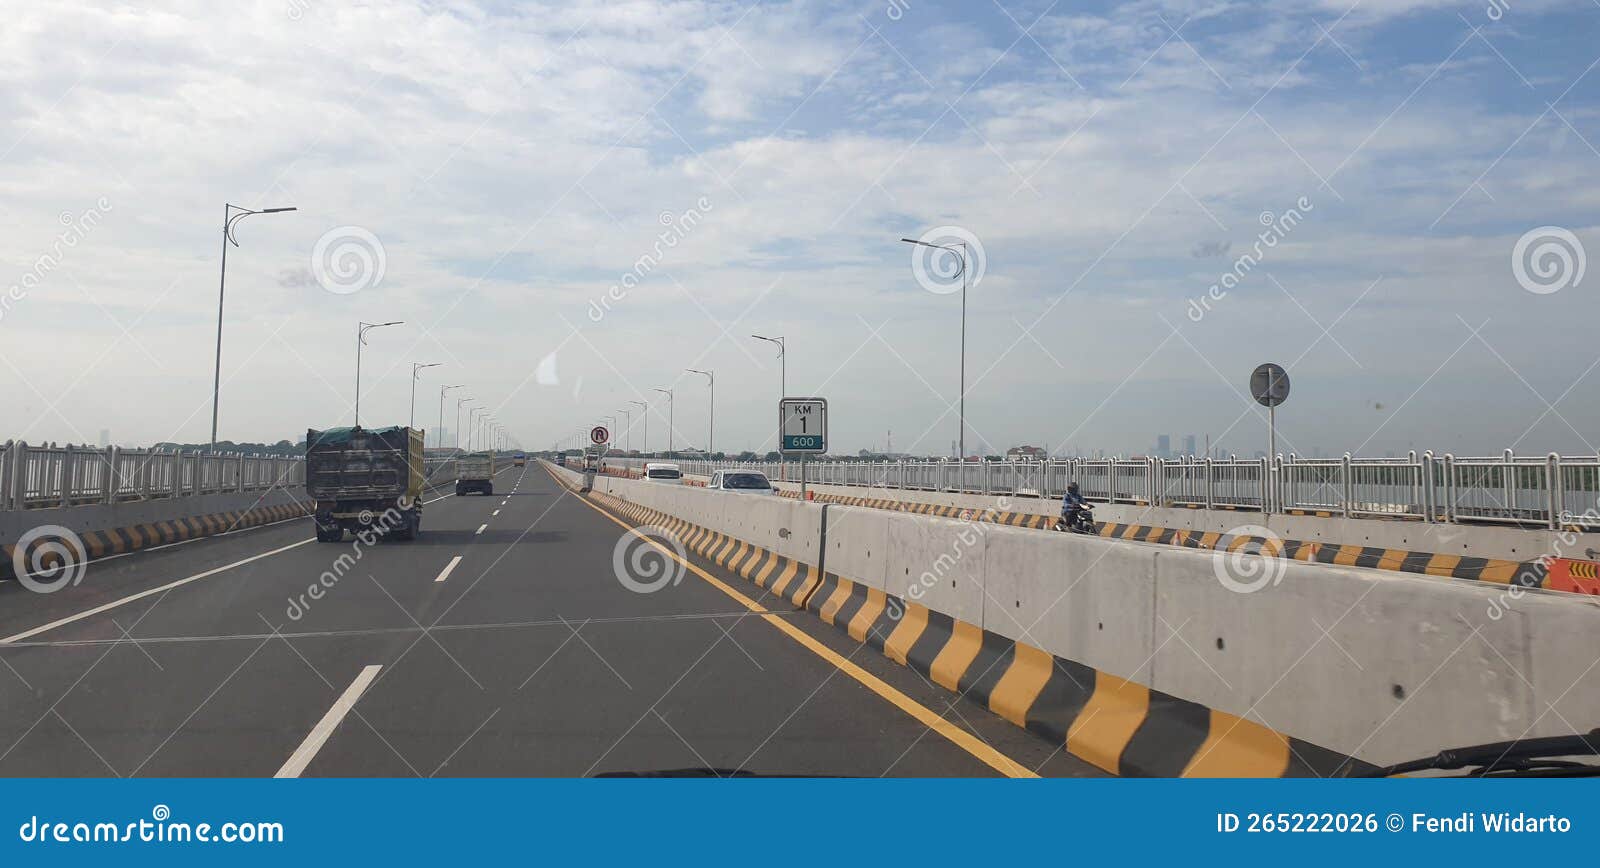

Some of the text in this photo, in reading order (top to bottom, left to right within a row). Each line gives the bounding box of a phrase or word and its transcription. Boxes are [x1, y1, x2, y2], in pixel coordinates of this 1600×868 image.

[794, 405, 811, 414] KM
[799, 416, 807, 433] 1
[792, 437, 814, 447] 600
